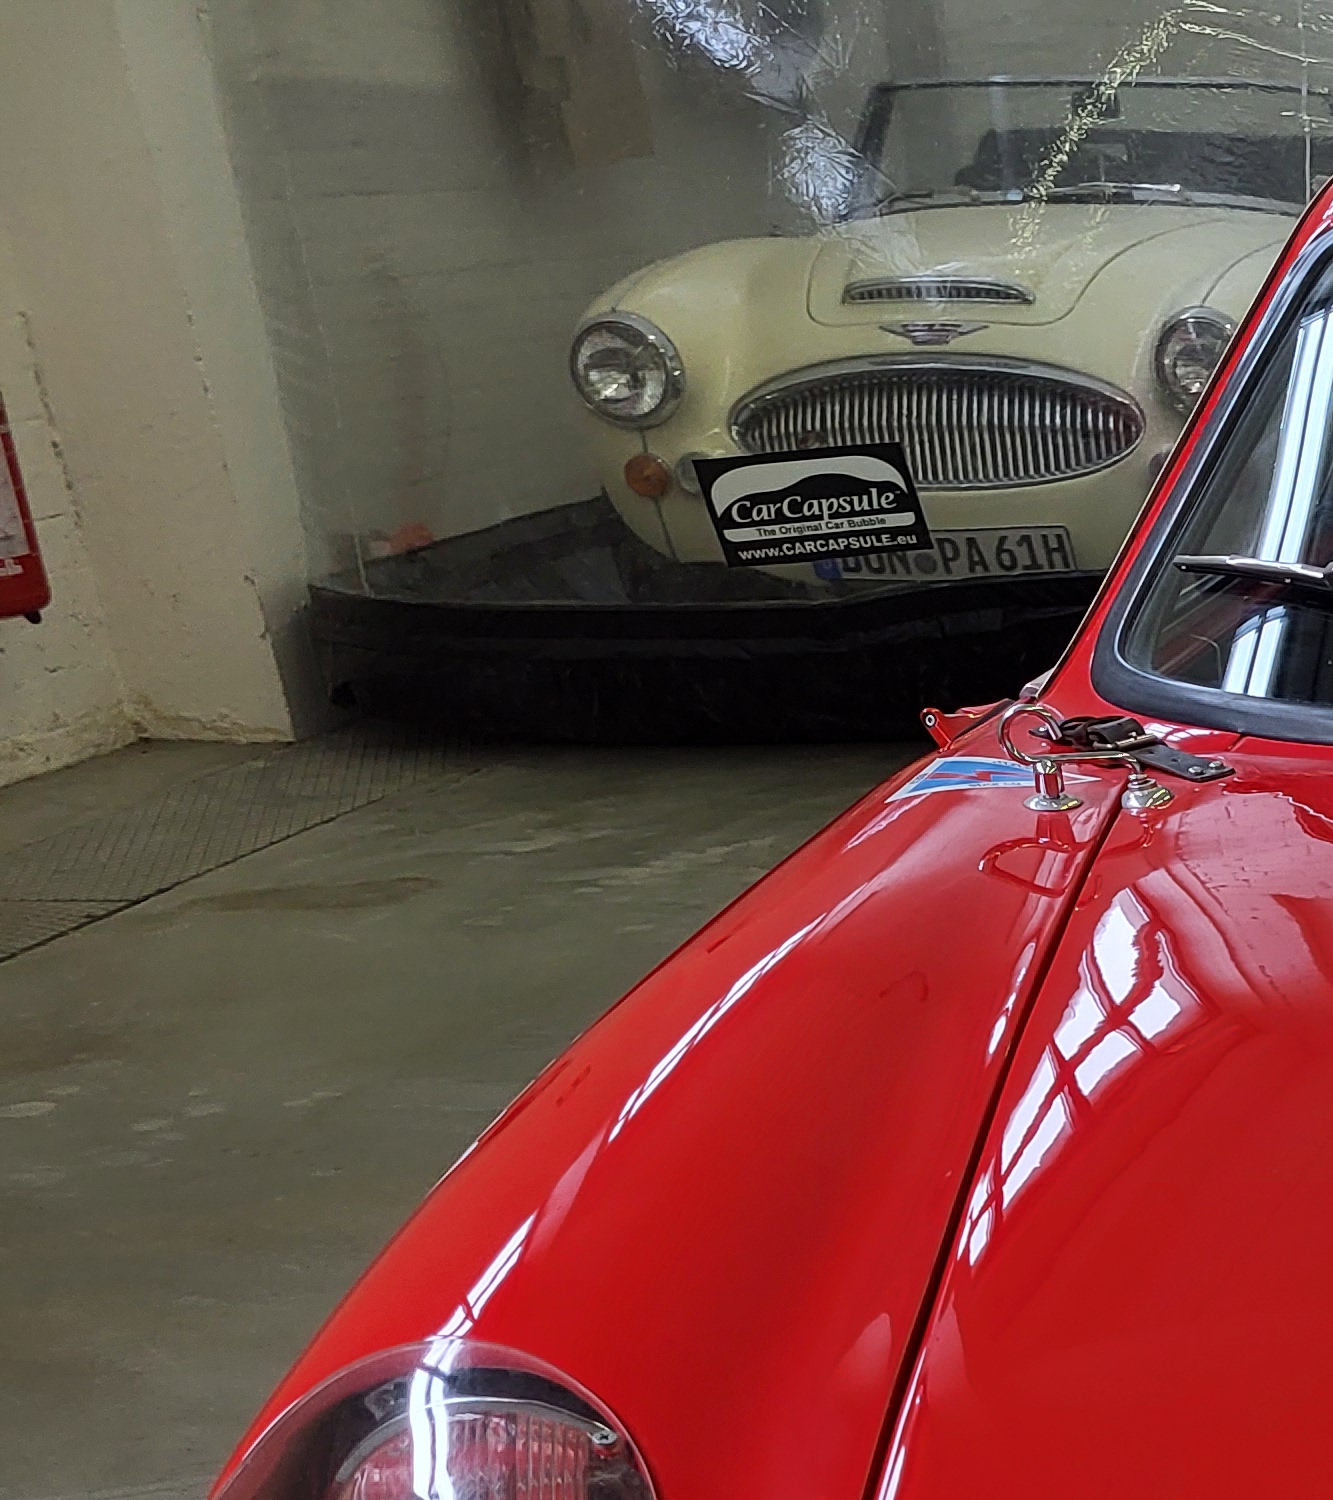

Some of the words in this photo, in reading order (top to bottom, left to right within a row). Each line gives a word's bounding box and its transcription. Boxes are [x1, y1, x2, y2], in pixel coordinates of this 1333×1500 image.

[731, 487, 897, 523] CarCapsule
[756, 527, 777, 538] The
[779, 522, 824, 536] Original
[825, 521, 845, 531] Car
[847, 515, 887, 529] Bubble
[738, 532, 918, 561] www.CARCAPSULE.eu
